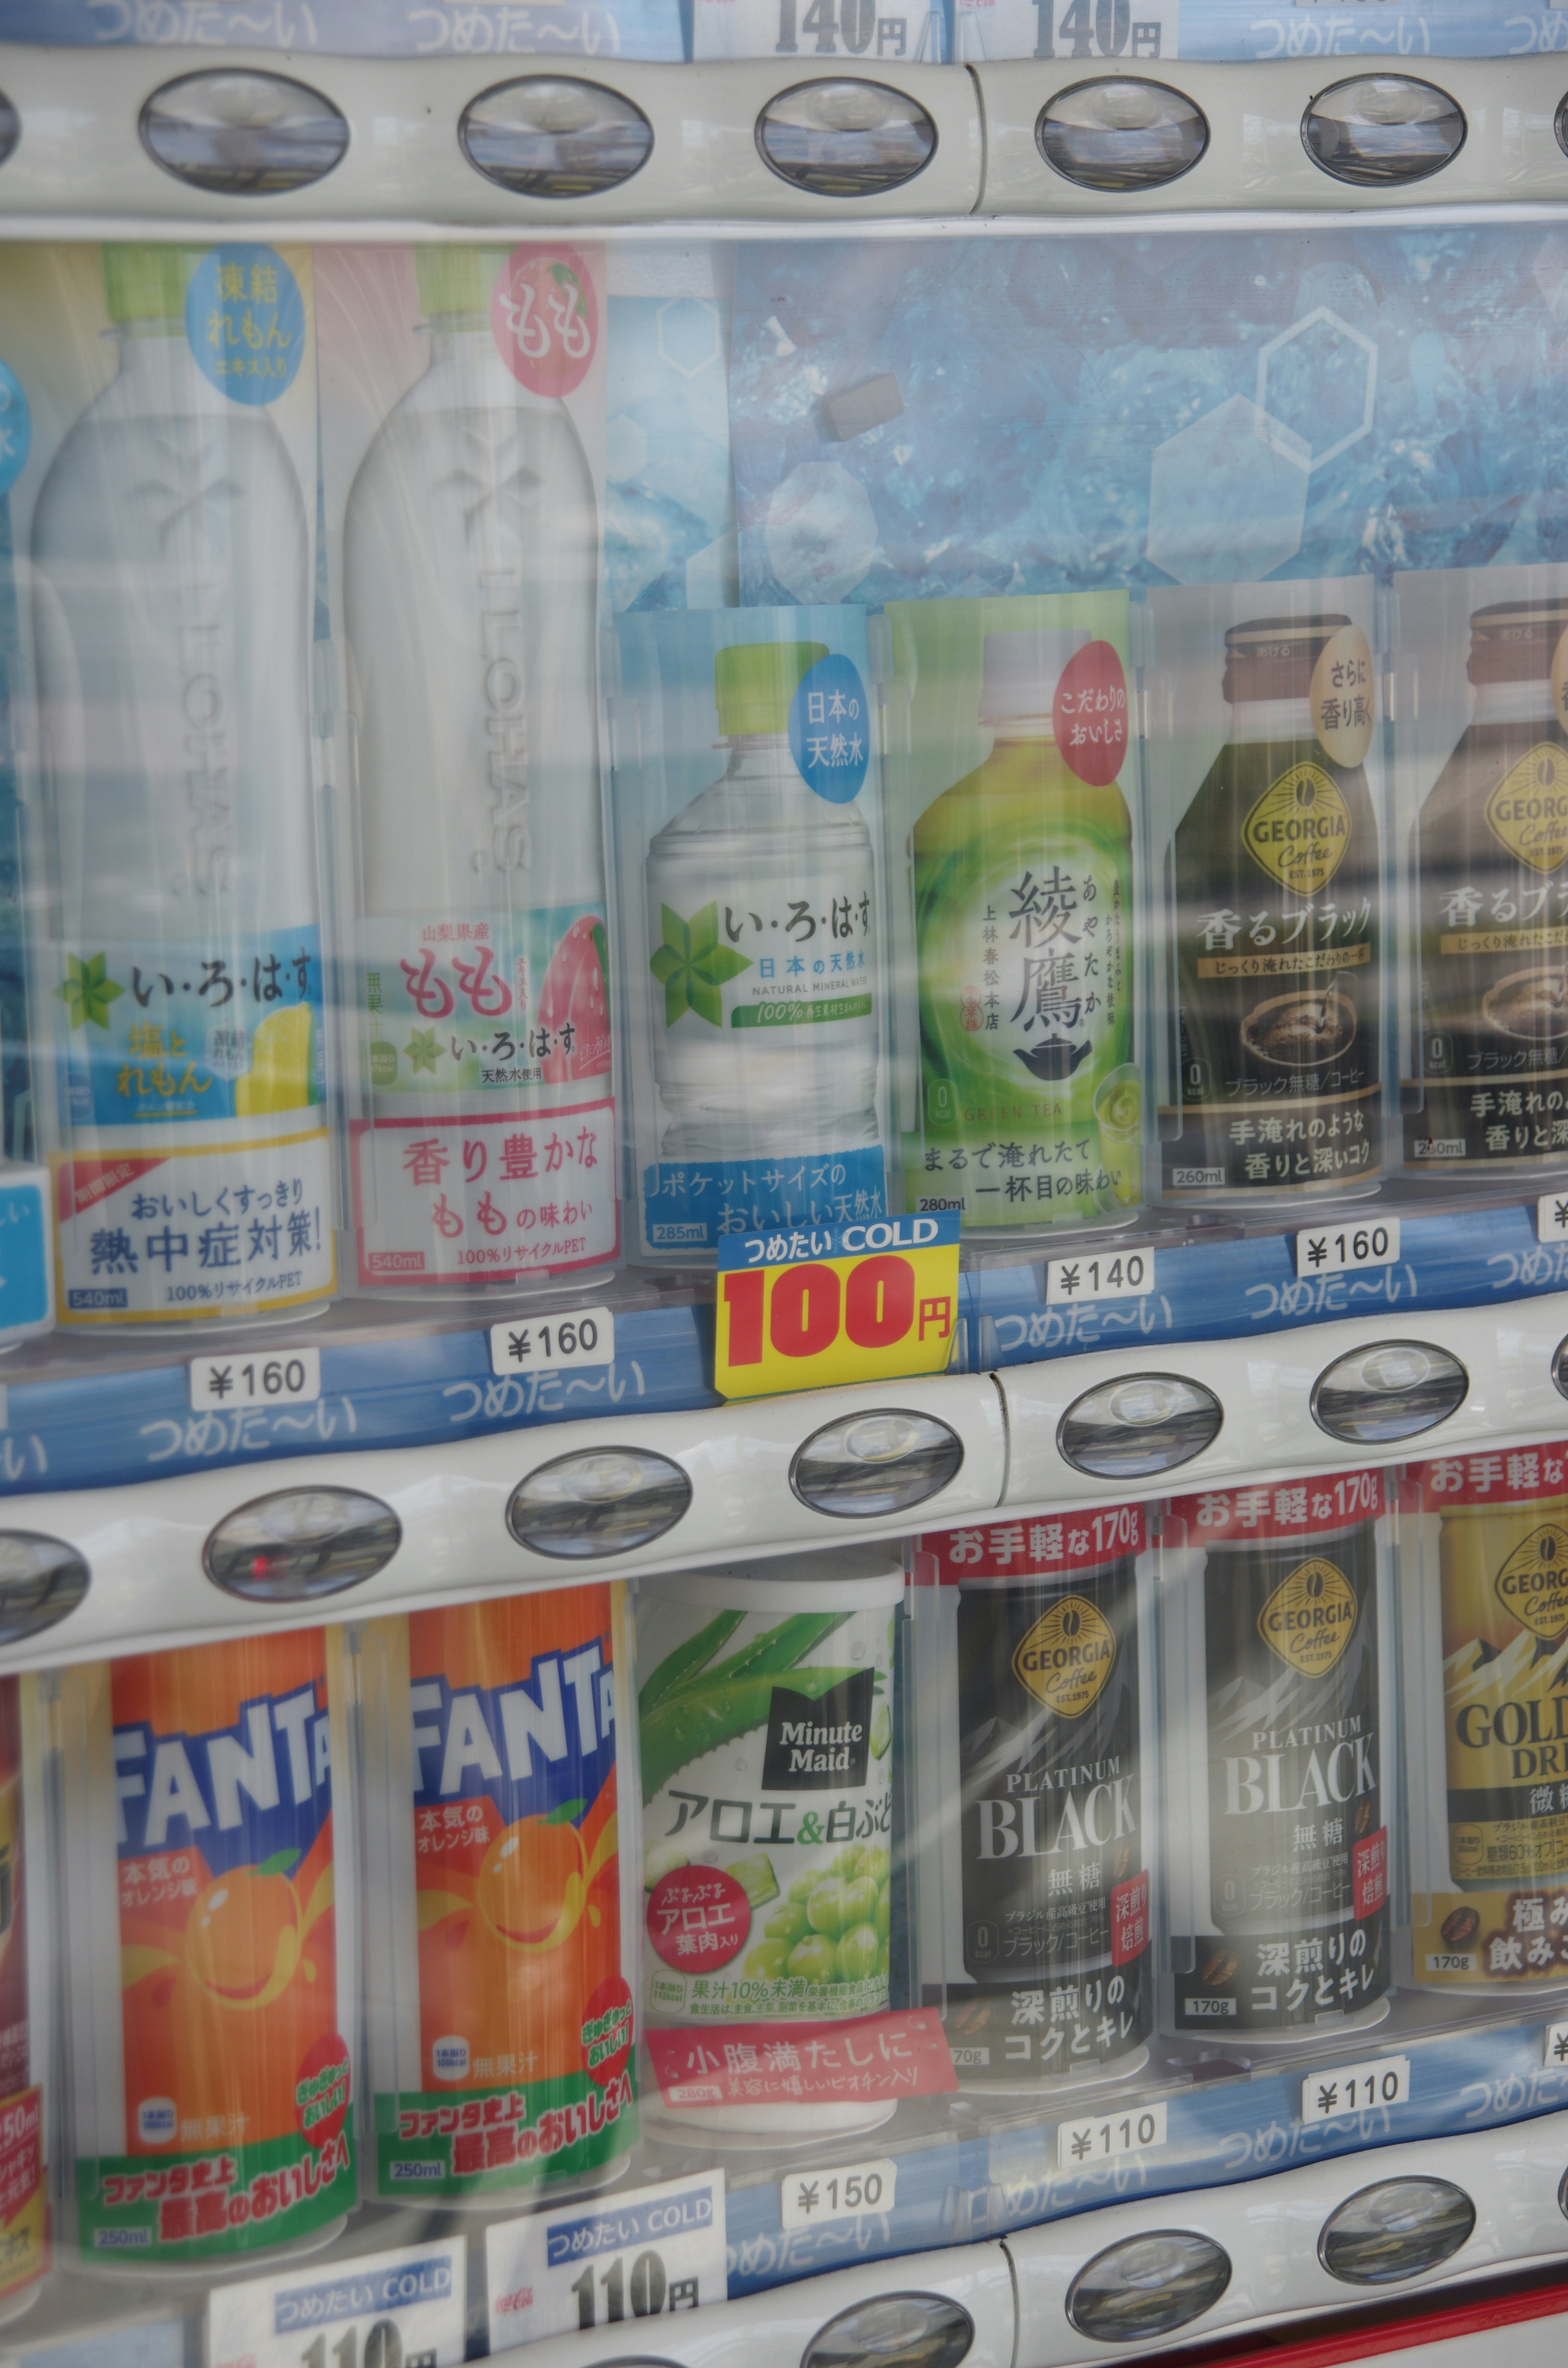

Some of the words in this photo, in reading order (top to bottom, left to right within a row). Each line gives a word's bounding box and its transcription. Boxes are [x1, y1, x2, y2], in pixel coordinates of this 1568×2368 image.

[215, 261, 279, 305] 凍結
[208, 308, 291, 350] れもん
[499, 283, 591, 358] もも
[214, 356, 287, 378] エキス入り
[1257, 645, 1291, 658] あける
[1331, 660, 1366, 688] さらに
[808, 689, 859, 725] 日本の
[1061, 685, 1125, 714] こだわりの
[1321, 694, 1372, 730] 香り高く
[1069, 718, 1123, 746] おいしさ
[807, 731, 864, 769] 天然水
[1253, 815, 1346, 844] GEORGIA
[1277, 840, 1333, 868] Coffee
[422, 922, 490, 942] 山梨県産
[1196, 897, 1372, 951] 香るブラック
[1008, 865, 1084, 1032] 綾鷹
[1082, 875, 1102, 1014] あやたか
[759, 949, 865, 979] 日本の天然水
[981, 904, 1001, 1030] 上林春松本店
[400, 945, 513, 1019] もも
[516, 957, 529, 1012] エキス入り
[752, 984, 808, 996] NATURAL
[812, 979, 849, 992] MINERAL
[851, 975, 867, 987] WATER
[127, 1020, 187, 1059] 塩と
[1432, 1037, 1442, 1059] 0
[117, 1061, 212, 1098] れもん
[481, 1067, 542, 1084] 天然水使用
[1190, 1063, 1201, 1086] 0
[1429, 1059, 1446, 1070] kcal
[937, 1086, 948, 1107] 0
[1188, 1086, 1204, 1096] kcal
[935, 1108, 952, 1119] kcal
[965, 1105, 1022, 1122] GREEN
[1033, 1102, 1063, 1117] TEA
[1229, 1108, 1365, 1147] 手淹れのような
[403, 1125, 598, 1186] 香り豊かな
[924, 1138, 1091, 1172] まるで淹れたて
[1245, 1138, 1370, 1180] 香りと深いコク
[74, 1162, 135, 1205] 期間限定
[662, 1163, 846, 1197] ポケットサイズの
[975, 1169, 1122, 1203] 一杯目の味わい
[1176, 1170, 1224, 1184] 260ml
[131, 1178, 304, 1220] おいしくすっきり
[432, 1190, 593, 1239] ももの味わい
[717, 1185, 883, 1234] おいしい天然水
[919, 1197, 967, 1212] 280ml
[90, 1206, 321, 1275] 熱中症対策!
[656, 1226, 705, 1241] 285ml
[745, 1230, 832, 1263] つめたい
[842, 1218, 939, 1252] COLD
[1308, 1227, 1389, 1268] ¥160
[372, 1254, 423, 1270] 540ml
[457, 1236, 587, 1266] 100%リサイクルPET
[168, 1270, 303, 1302] 100%リサイクルPET
[1061, 1255, 1144, 1295] ¥140
[72, 1290, 126, 1307] 540ml
[723, 1254, 952, 1368] 100円
[508, 1318, 599, 1363] ¥160
[208, 1359, 306, 1399] ¥160
[1196, 1471, 1378, 1528] お手軽な170g
[949, 1507, 1139, 1565] お手軽な170g
[1268, 1603, 1353, 1633] GEORGIA
[1550, 1614, 1566, 1624] 1975
[1022, 1642, 1112, 1672] GEORGIA
[1290, 1628, 1340, 1654] Coffee
[1300, 1653, 1315, 1664] EST.
[1316, 1651, 1333, 1661] 1975
[1046, 1665, 1098, 1694] Coffee
[1056, 1693, 1072, 1703] EST.
[1072, 1690, 1090, 1701] 1975
[410, 1645, 615, 1795] FANTA
[779, 1721, 863, 1746] Minute
[1252, 1714, 1362, 1751] PLATINUM
[114, 1688, 331, 1848] FANTA
[788, 1746, 850, 1772] Maid
[1006, 1755, 1121, 1793] PLATINUM
[1222, 1732, 1377, 1815] BLACK
[419, 1805, 483, 1832] 本気の
[975, 1773, 1138, 1860] BLACK
[417, 1825, 491, 1854] オレンジ味
[1293, 1818, 1344, 1852] 無糖
[123, 1855, 191, 1885] 本気の
[1357, 1840, 1387, 1878] 深煎り
[122, 1878, 198, 1908] オレンジ味
[1047, 1862, 1101, 1897] 無糖
[1249, 1881, 1352, 1911] ブラック/コーヒー
[1362, 1873, 1384, 1906] 焙煎
[656, 1903, 735, 1935] アロエ
[1116, 1885, 1147, 1923] 深煎り
[675, 1932, 739, 1956] 葉肉入り
[977, 1926, 989, 1948] 0
[1003, 1928, 1110, 1958] ブラック/コーヒー
[1121, 1916, 1145, 1952] 焙煎
[975, 1949, 992, 1959] kcal
[1256, 1929, 1367, 1977] 深煎りの
[1433, 1955, 1470, 1970] 170g
[653, 1991, 683, 2002] 112kcal
[654, 1981, 684, 1992] 1本当り
[692, 1978, 806, 2000] 果汁10%未満
[1011, 1975, 1125, 2026] 深煎りの
[1251, 1964, 1375, 2011] コクとキレ
[1193, 2000, 1230, 2015] 170g
[686, 2032, 913, 2074] 小腹満たしに
[1004, 2011, 1134, 2061] コクとキレ
[472, 2051, 539, 2079] 無果汁
[728, 2066, 918, 2098] 美容に嬉しいビオチン入り
[678, 2088, 715, 2100] 280g
[1318, 2071, 1399, 2114] ¥110
[399, 2090, 526, 2141] ファンタ史上
[451, 2070, 633, 2175] 最高のおいしさへ
[1071, 2113, 1155, 2161] ¥110
[102, 2154, 237, 2206] ファンタ史上
[158, 2132, 350, 2243] 最高のおいしさへ
[394, 2163, 442, 2178] 250ml
[798, 2173, 883, 2214] ¥150
[98, 2230, 148, 2247] 250ml
[548, 2217, 640, 2258] つめたい
[648, 2198, 712, 2232] COLD
[276, 2284, 374, 2325] つめたい
[383, 2267, 452, 2300] COLD
